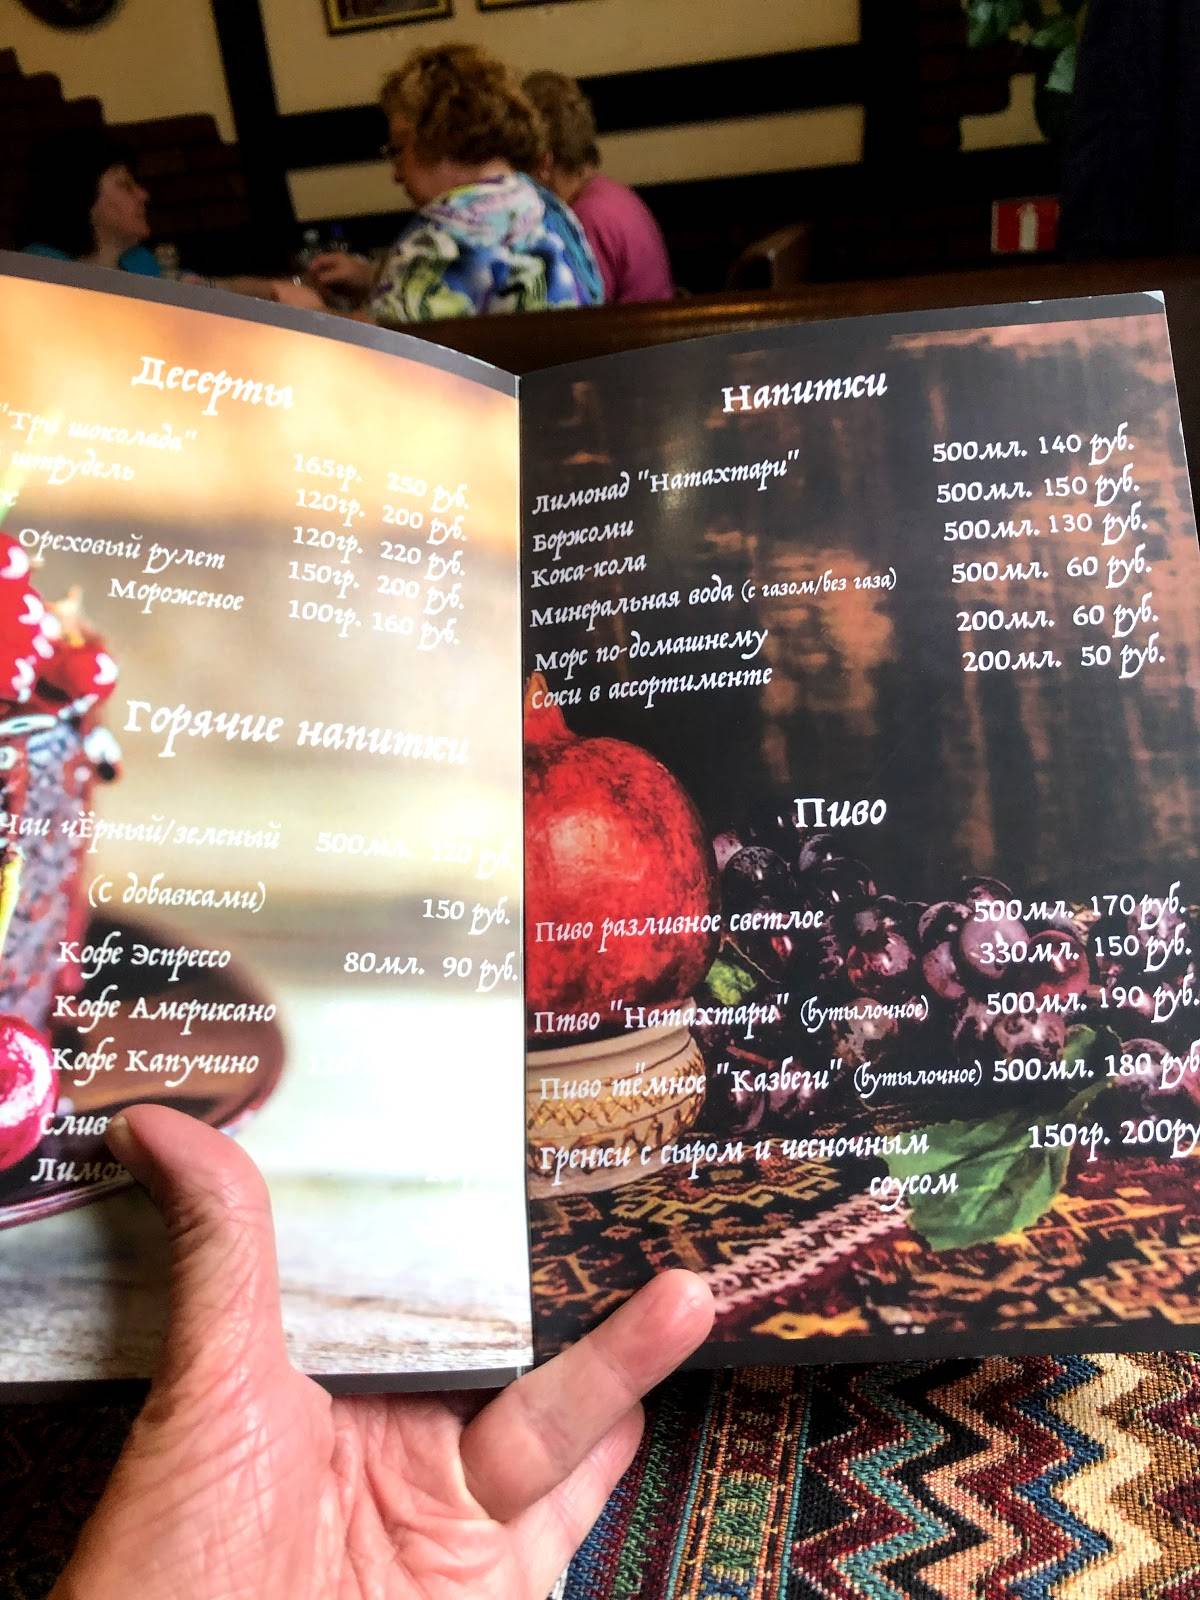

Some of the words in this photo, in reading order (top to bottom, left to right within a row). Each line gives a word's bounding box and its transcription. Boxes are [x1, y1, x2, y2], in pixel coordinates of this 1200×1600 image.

[131, 356, 293, 416] Десерты
[721, 372, 888, 413] Напитки
[932, 440, 1028, 463] 500мл.
[1038, 434, 1082, 455] 140
[1088, 421, 1135, 466] руб.
[293, 453, 363, 492] 165гр.
[387, 471, 427, 496] 250
[430, 484, 469, 513] руб.
[531, 471, 630, 515] Лимонад
[638, 448, 800, 492] "Натахтари"
[936, 481, 1033, 504] 500мл.
[1044, 476, 1088, 497] 150
[1093, 463, 1141, 508] руб.
[295, 488, 365, 527] 120гр.
[382, 504, 423, 529] 200
[426, 515, 467, 545] руб.
[532, 519, 634, 561] Боржоми
[943, 520, 1041, 541] 500мл.
[1048, 512, 1093, 534] 130
[1101, 501, 1148, 546] руб.
[18, 528, 140, 562] Ореховый
[143, 542, 225, 574] рулет
[293, 526, 363, 564] 120гр.
[380, 541, 422, 565] 220
[424, 550, 465, 581] руб.
[530, 555, 647, 588] Кока-кола
[951, 561, 1049, 584] 500мл.
[1066, 556, 1098, 577] 60
[1105, 543, 1152, 589] руб.
[108, 578, 245, 614] Мороженое
[288, 560, 360, 599] 150гр.
[377, 575, 420, 598] 200
[423, 583, 465, 615] руб.
[530, 591, 680, 632] Минеральная
[688, 574, 734, 602] вода
[741, 579, 756, 603] (с
[761, 570, 847, 599] газом/без
[853, 567, 897, 591] газа)
[288, 600, 362, 638] 100гр.
[372, 612, 415, 635] 160
[416, 618, 459, 651] руб.
[956, 609, 1055, 632] 200мл.
[1072, 605, 1105, 626] 60
[1112, 592, 1159, 638] руб.
[534, 647, 588, 680] Морс
[596, 627, 768, 662] по-домашнему
[962, 650, 1062, 672] 200мл.
[1080, 645, 1111, 666] 50
[1118, 632, 1166, 679] руб.
[589, 685, 601, 702] в
[609, 665, 772, 709] ассортименте
[123, 700, 284, 758] Горячие
[297, 719, 471, 764] напитки
[793, 797, 887, 829] Пиво
[122, 872, 266, 914] добавками)
[422, 898, 465, 921] 150
[468, 896, 510, 935] руб.
[973, 899, 1074, 923] 500мл.
[1090, 894, 1136, 916] 170
[1138, 880, 1186, 931] руб.
[535, 920, 594, 943] Пиво
[598, 913, 721, 953] разливное
[729, 908, 824, 931] светлое
[979, 940, 1080, 964] 330мл.
[1094, 935, 1140, 957] 150
[1143, 922, 1192, 973] руб.
[57, 931, 124, 980] Кофе
[130, 943, 231, 982] Эспрессо
[343, 951, 425, 975] 80мл.
[442, 957, 472, 978] 90
[475, 951, 518, 993] руб.
[52, 984, 121, 1033] Кофе
[127, 996, 277, 1035] Американо
[609, 992, 790, 1039] "Натахтари"
[800, 995, 929, 1032] (бутылочное)
[985, 992, 1087, 1015] 500мл.
[1099, 986, 1144, 1009] 190
[1150, 972, 1200, 1023] руб.
[50, 1037, 115, 1087] Кофе
[125, 1049, 260, 1087] Капучино
[539, 1077, 602, 1100] Пиво
[716, 1056, 842, 1093] "Казбеги"
[853, 1060, 983, 1099] (бутылочное)
[992, 1058, 1095, 1082] 500мл.
[1104, 1052, 1152, 1077] 180
[41, 1112, 112, 1136] Слив
[1028, 1122, 1111, 1162] 150гр.
[539, 1144, 631, 1187] Гренки
[640, 1144, 651, 1166] с
[660, 1139, 745, 1180] сыром
[752, 1141, 771, 1162] и
[780, 1132, 930, 1161] чесночным
[869, 1171, 959, 1212] соусом
